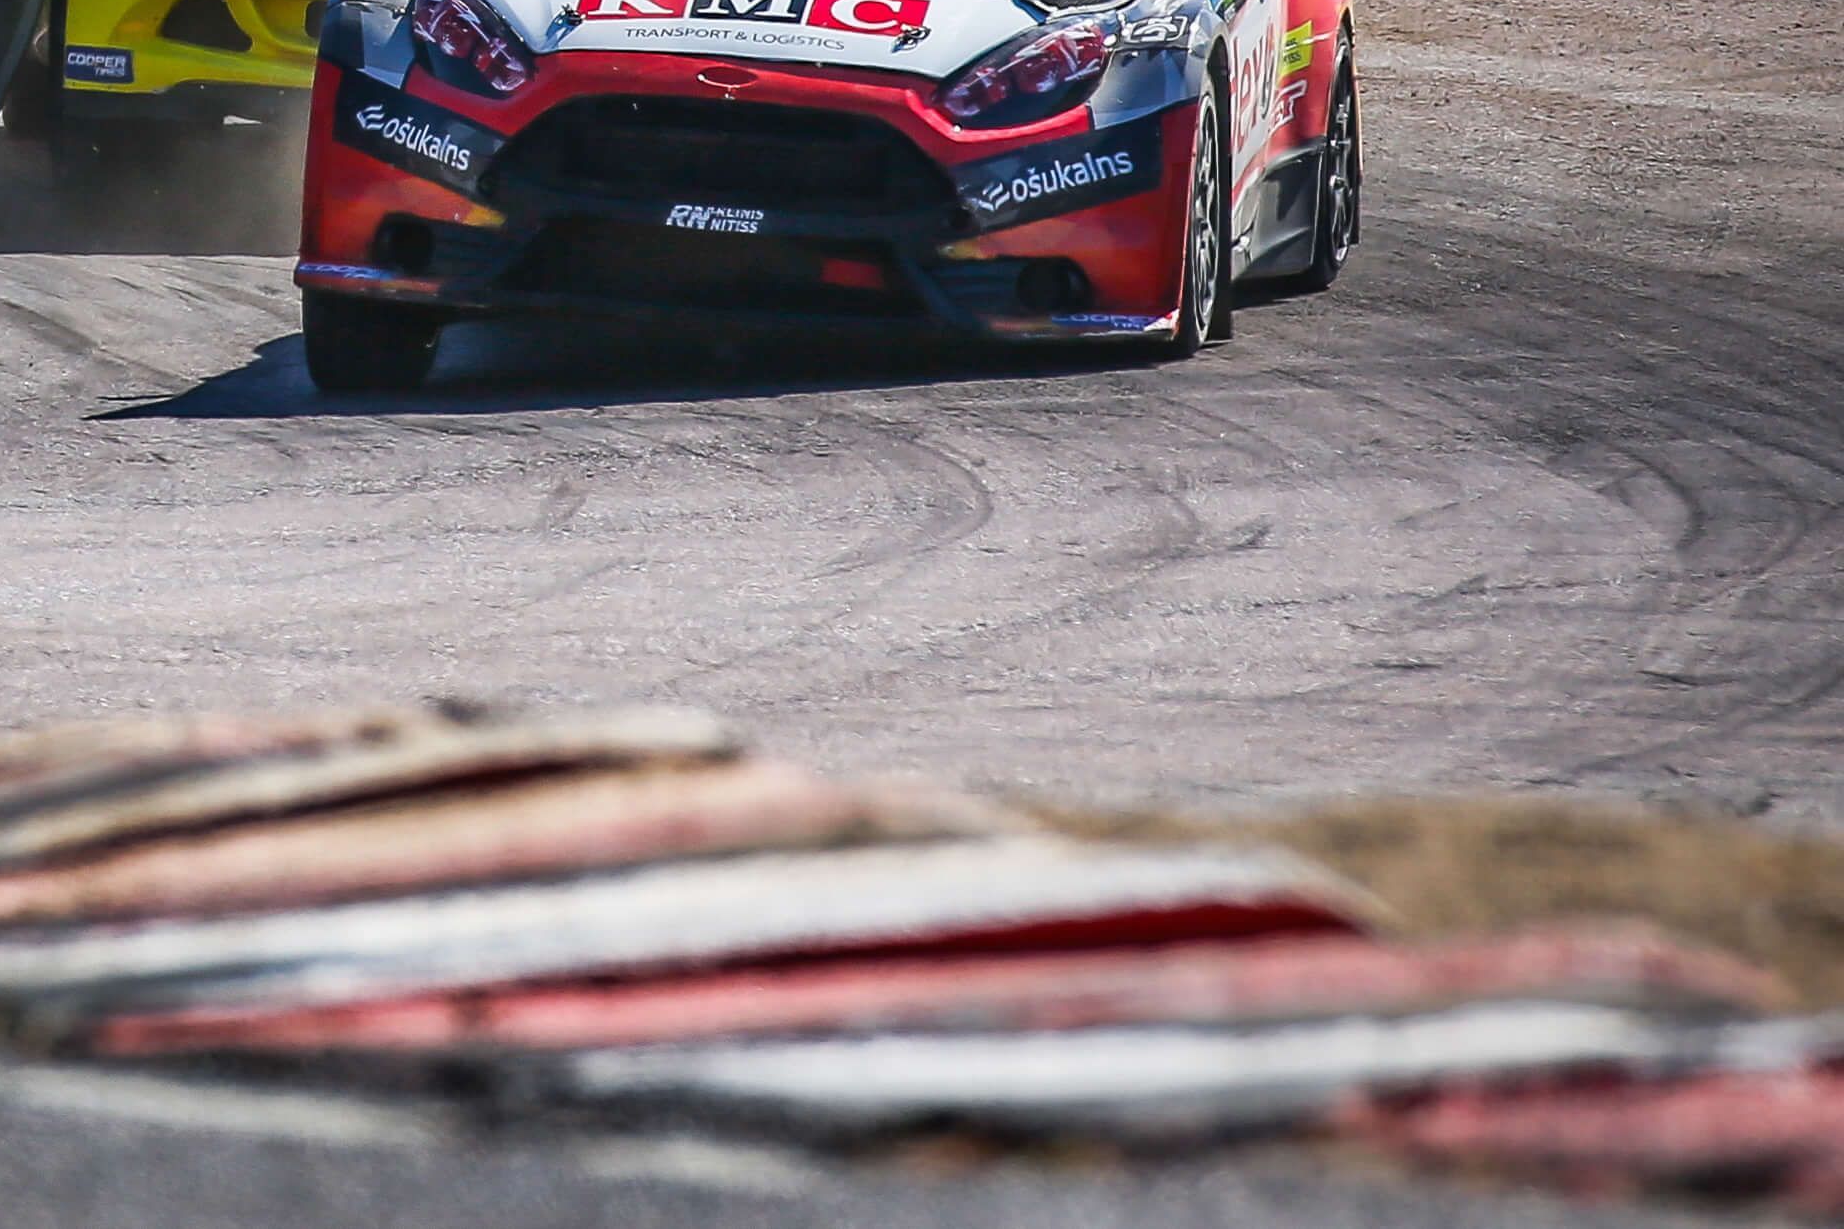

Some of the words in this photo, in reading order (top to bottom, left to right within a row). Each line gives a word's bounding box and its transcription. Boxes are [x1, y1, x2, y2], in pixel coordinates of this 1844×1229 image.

[624, 27, 731, 41] TRANSPORT
[734, 30, 748, 42] &
[751, 31, 846, 51] LOGISTICS
[66, 51, 127, 68] COOPER
[1011, 150, 1135, 203] ošukalns
